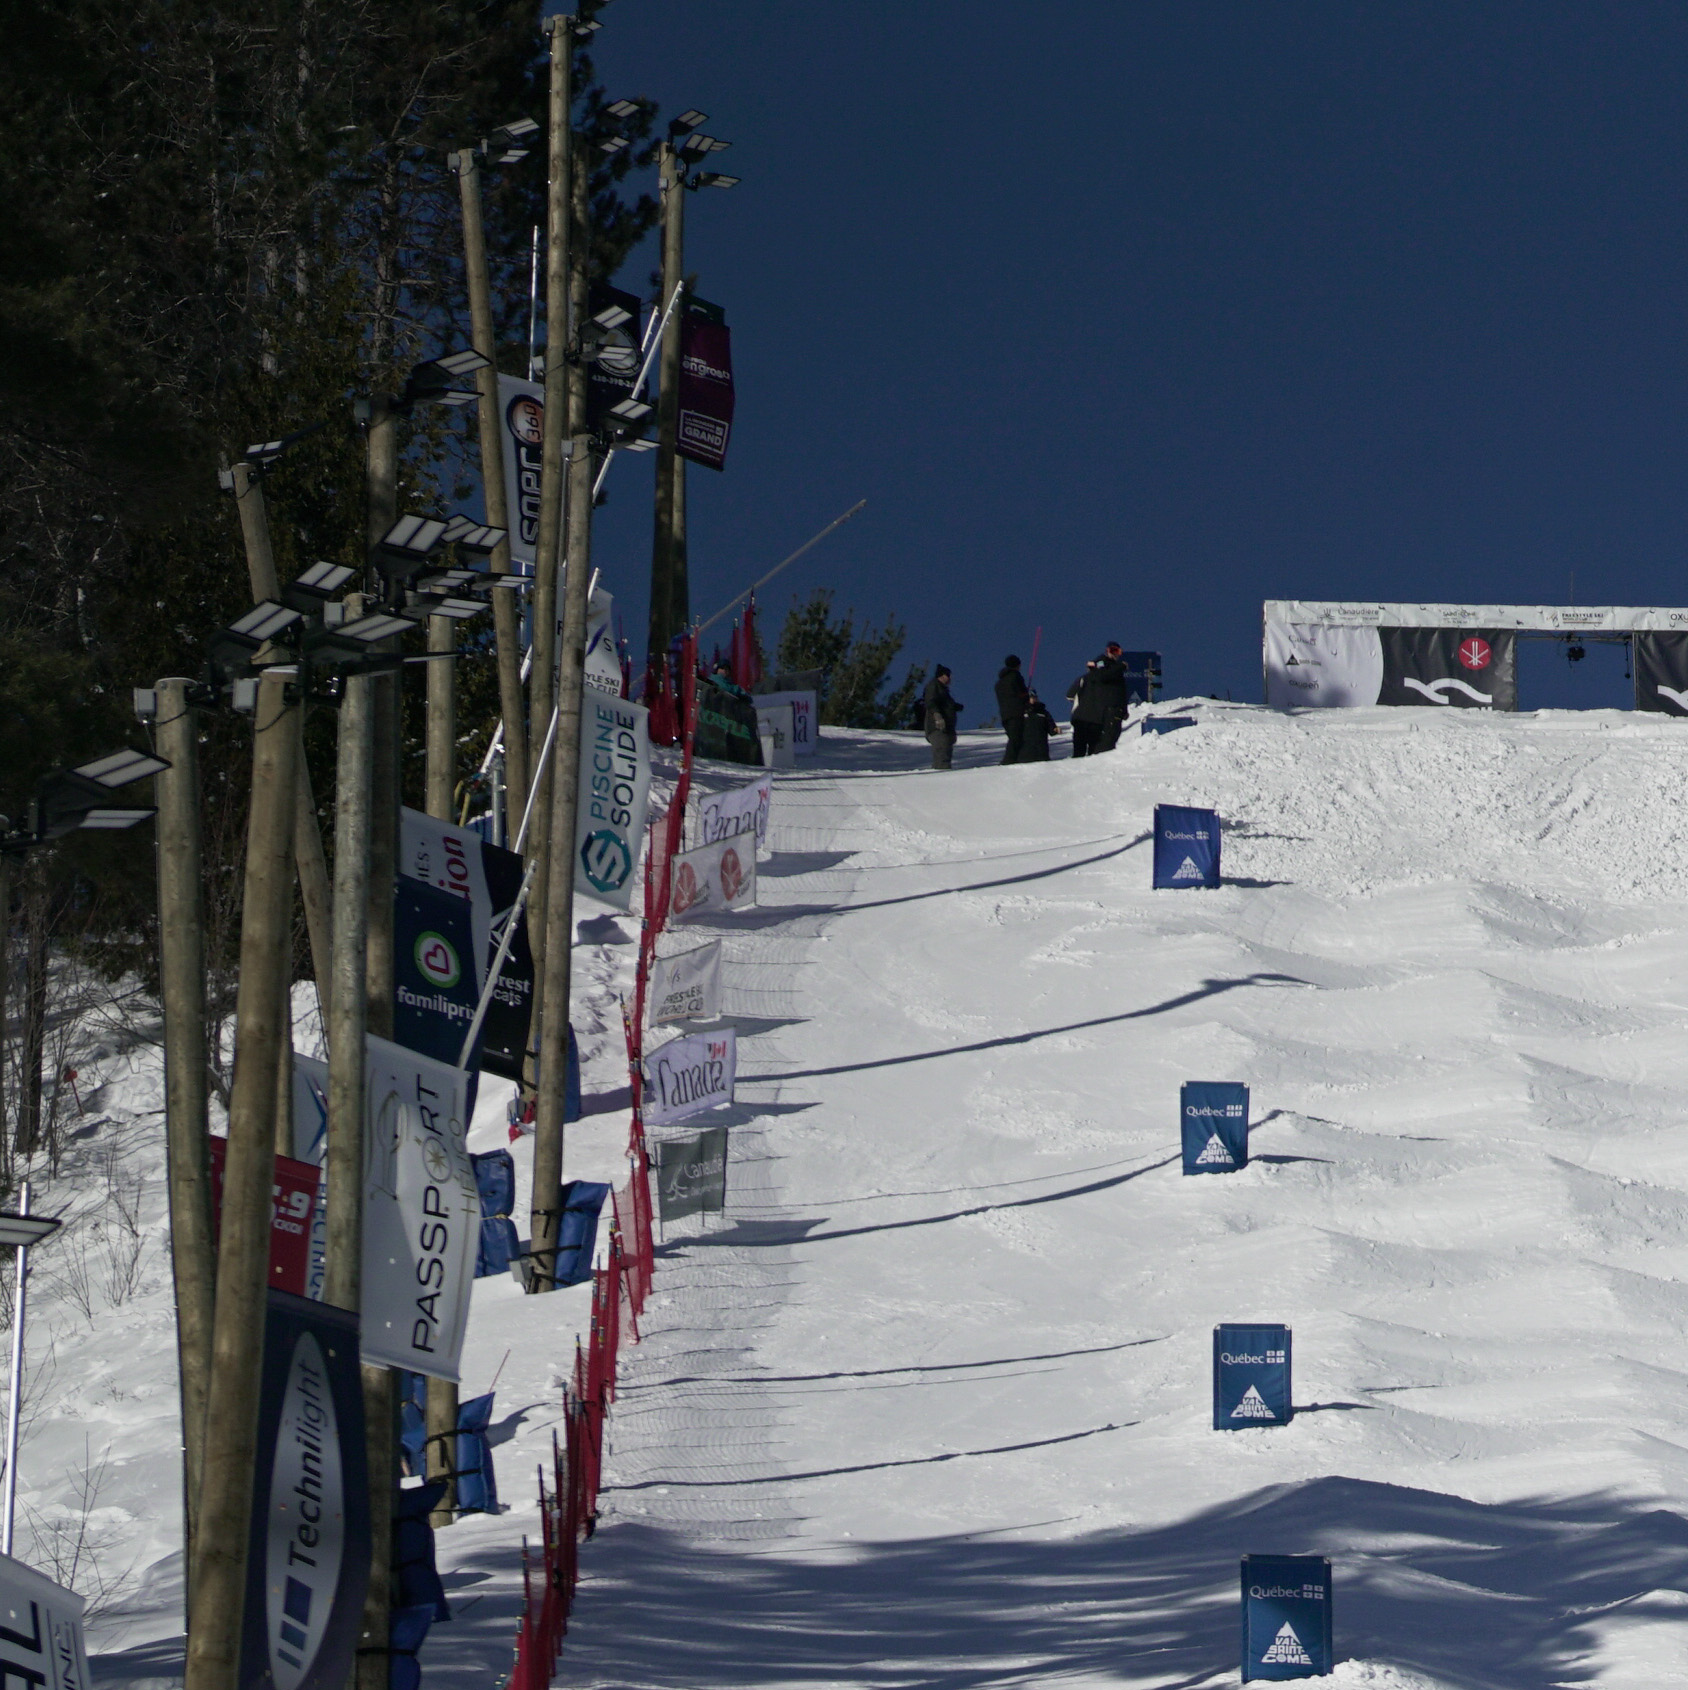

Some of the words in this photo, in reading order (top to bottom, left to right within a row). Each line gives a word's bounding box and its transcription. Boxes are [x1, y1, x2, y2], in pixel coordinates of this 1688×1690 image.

[684, 427, 723, 447] GRAND
[590, 703, 615, 821] PISCINE
[611, 711, 636, 828] SOLIDE
[1186, 1104, 1226, 1118] Québec
[411, 1073, 451, 1353] PASSPORT
[1220, 1352, 1265, 1366] Québec
[288, 1360, 332, 1568] Technilight
[1249, 1584, 1301, 1600] Québec
